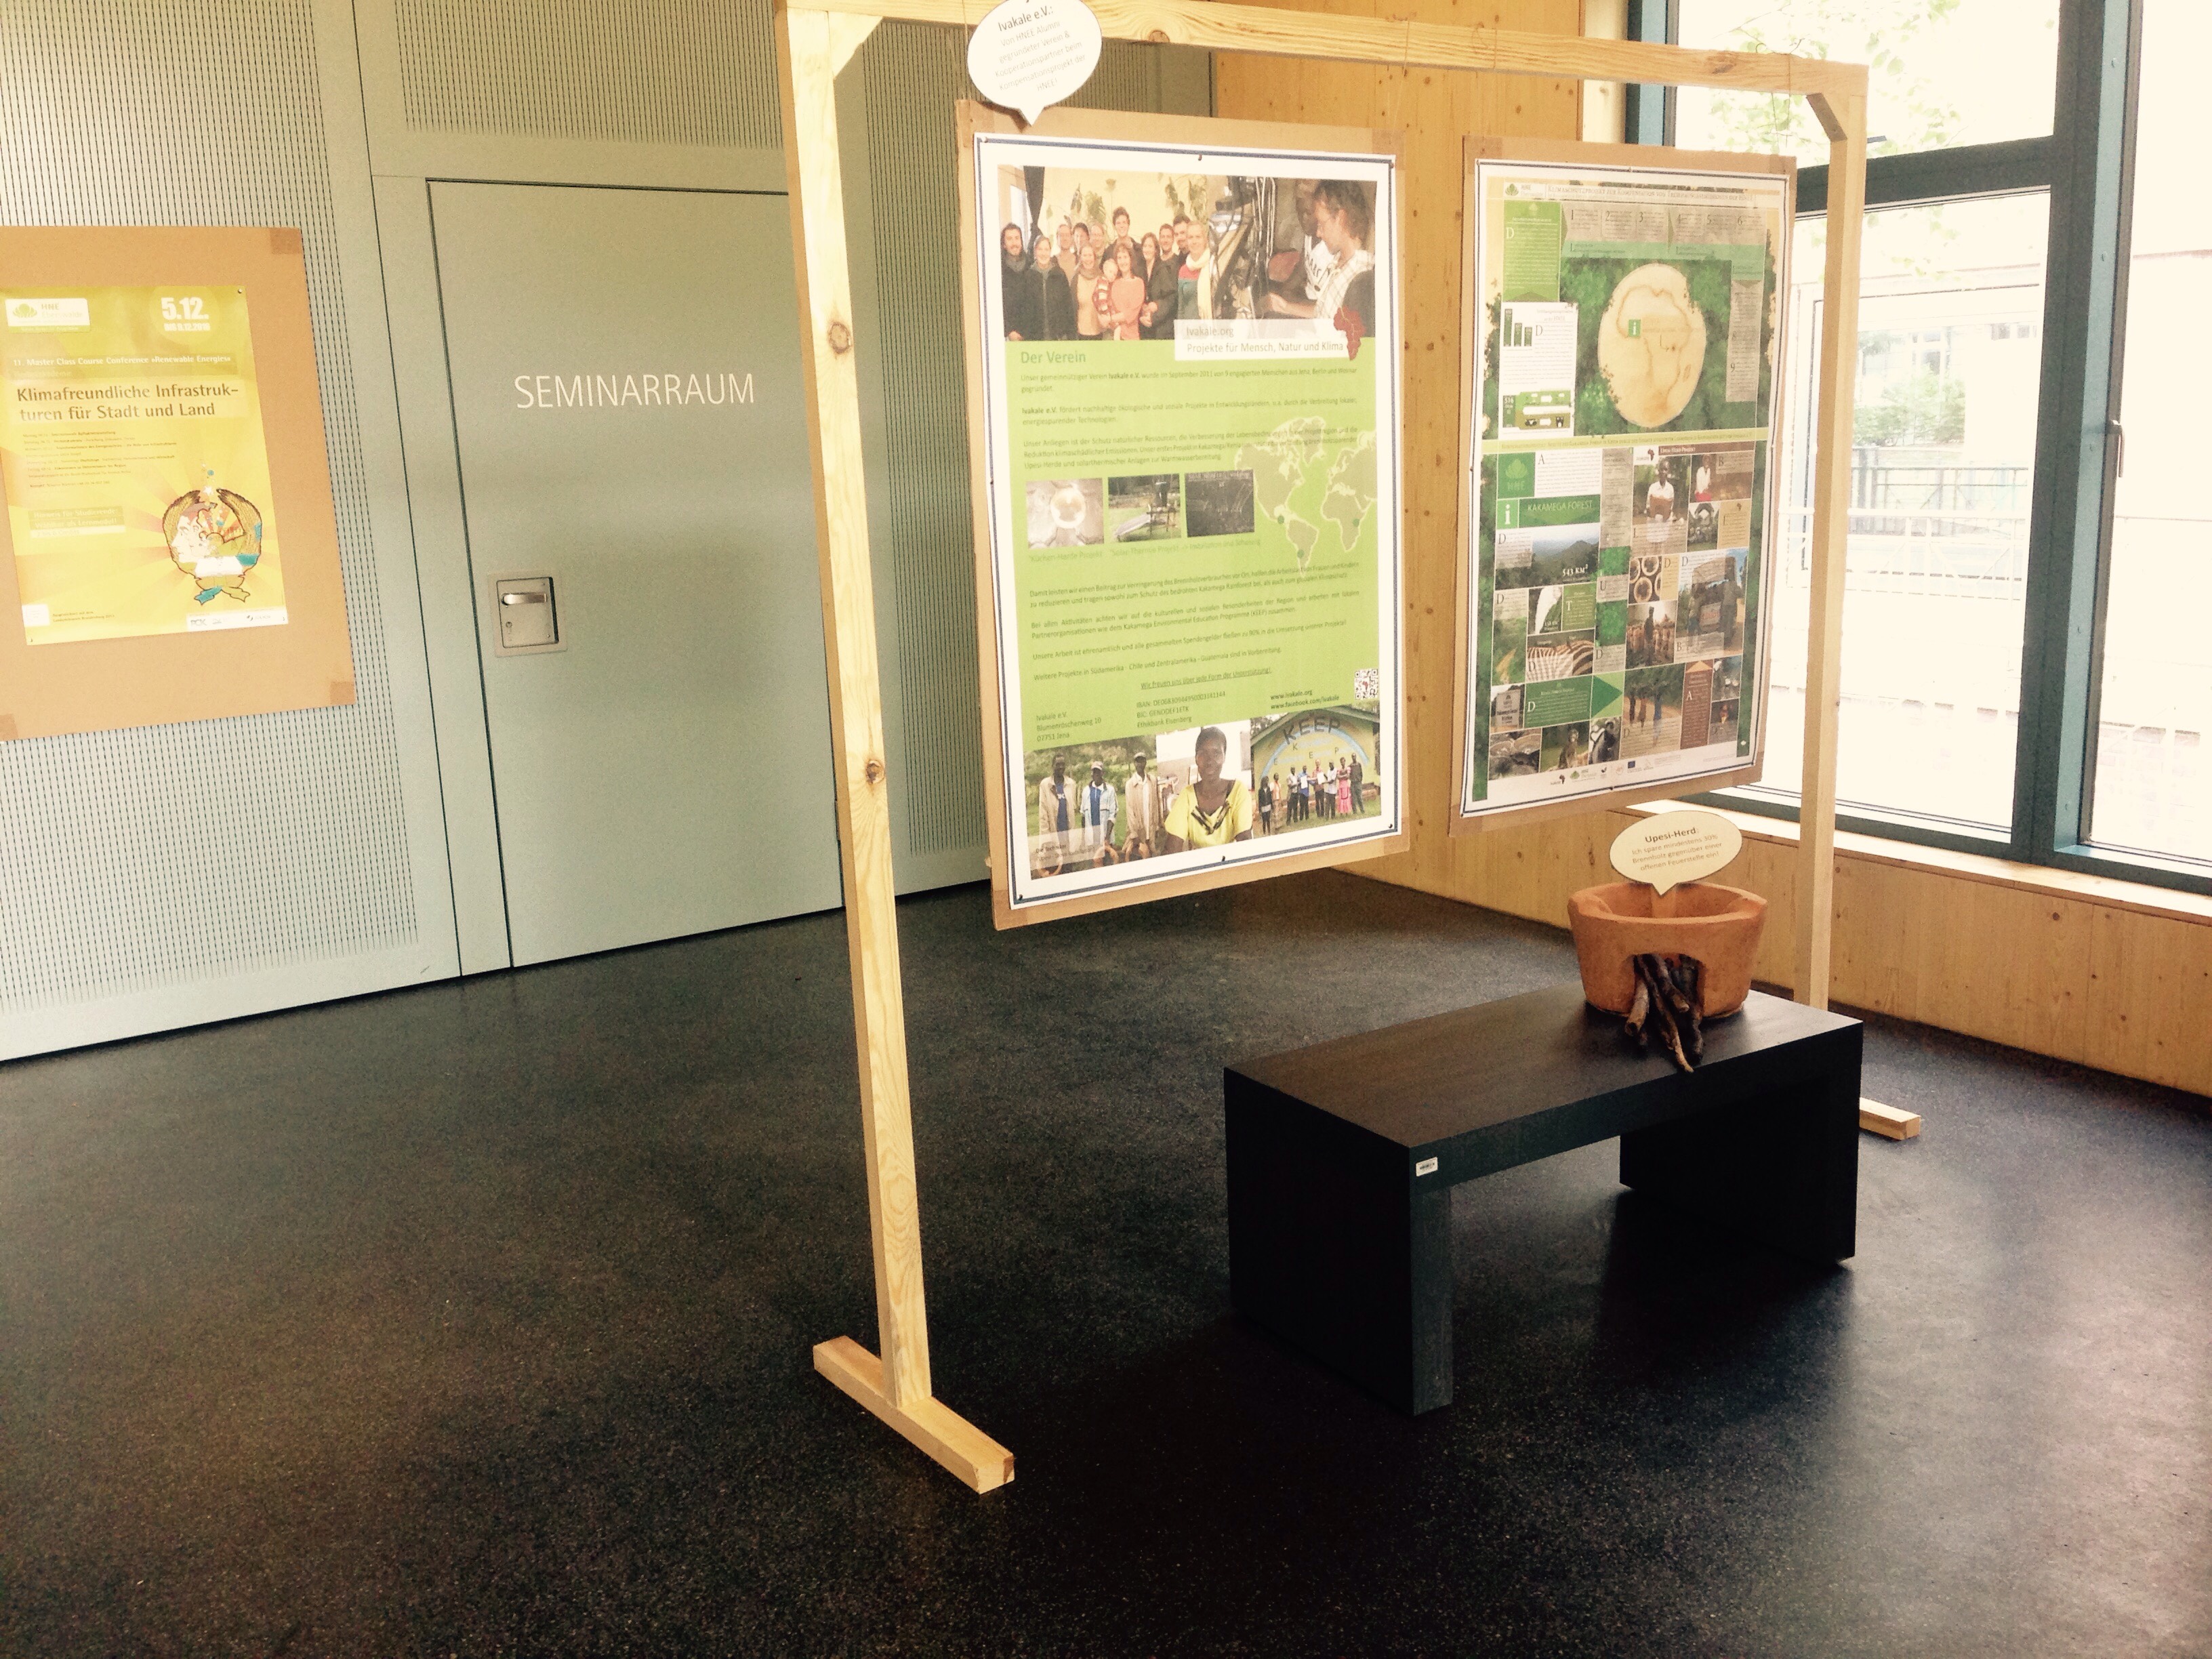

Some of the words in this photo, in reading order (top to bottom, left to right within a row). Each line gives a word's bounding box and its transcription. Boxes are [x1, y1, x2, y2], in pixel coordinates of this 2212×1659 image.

[998, 13, 1031, 31] Ivakale
[1034, 5, 1053, 19] e.V.:
[1000, 36, 1015, 46] Von
[1016, 30, 1034, 41] HNEE
[1037, 20, 1060, 34] Alumni
[999, 42, 1040, 64] gegründeter
[1041, 33, 1063, 46] Verein
[1064, 30, 1070, 38] &
[995, 48, 1064, 77] Kooperationspartner
[1065, 41, 1083, 52] beim
[999, 58, 1073, 91] Kompensationsprojekt
[1075, 54, 1086, 64] der
[161, 297, 209, 320] 5.12.
[1186, 327, 1233, 337] Ivakale.org
[1021, 351, 1042, 363] Der
[1046, 350, 1086, 363] Verein
[1187, 343, 1223, 354] Projekte
[1226, 343, 1237, 352] für
[1240, 343, 1275, 352] Mensch,
[1279, 343, 1301, 351] Natur
[1304, 342, 1319, 351] und
[1322, 342, 1343, 351] Klima
[17, 386, 150, 401] Klimafreundliche
[157, 384, 239, 397] Infrastruk-
[514, 373, 755, 408] SEMINARRAUM
[19, 409, 62, 421] turen
[68, 407, 91, 419] für
[98, 405, 140, 419] Stadt
[145, 404, 173, 417] und
[180, 403, 215, 416] Land
[1528, 502, 1565, 512] KAKAMEGA
[1568, 500, 1593, 510] FOREST
[1284, 712, 1340, 744] KEEP
[1643, 846, 1662, 855] spare
[1664, 838, 1702, 850] mindestens
[1704, 834, 1718, 842] 30%
[1632, 853, 1666, 863] Brennholz
[1640, 862, 1667, 872] offenen
[1668, 854, 1704, 865] Feuerstelle
